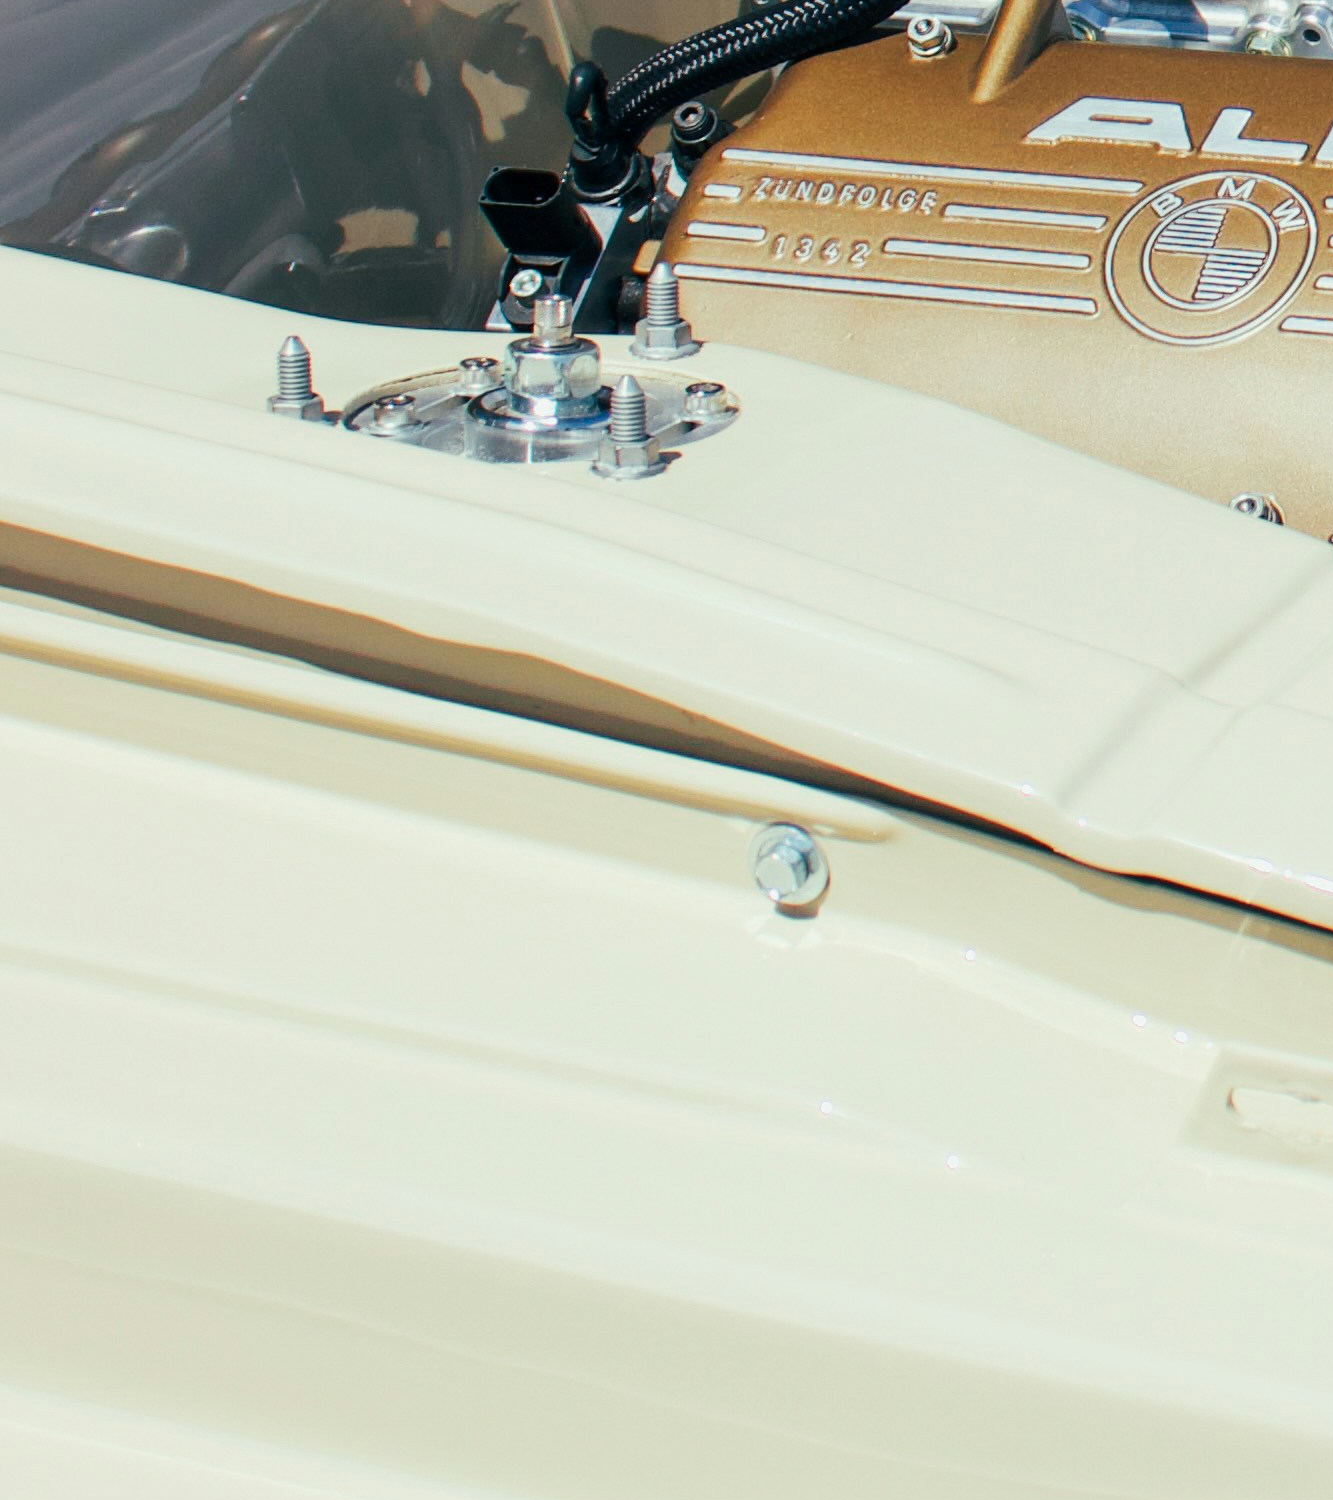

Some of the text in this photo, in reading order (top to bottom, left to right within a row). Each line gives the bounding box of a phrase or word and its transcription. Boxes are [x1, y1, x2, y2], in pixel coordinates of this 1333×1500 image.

[753, 176, 940, 217] ZÜNDFOLGE
[1150, 175, 1307, 234] BMW
[771, 234, 873, 268] 1342
